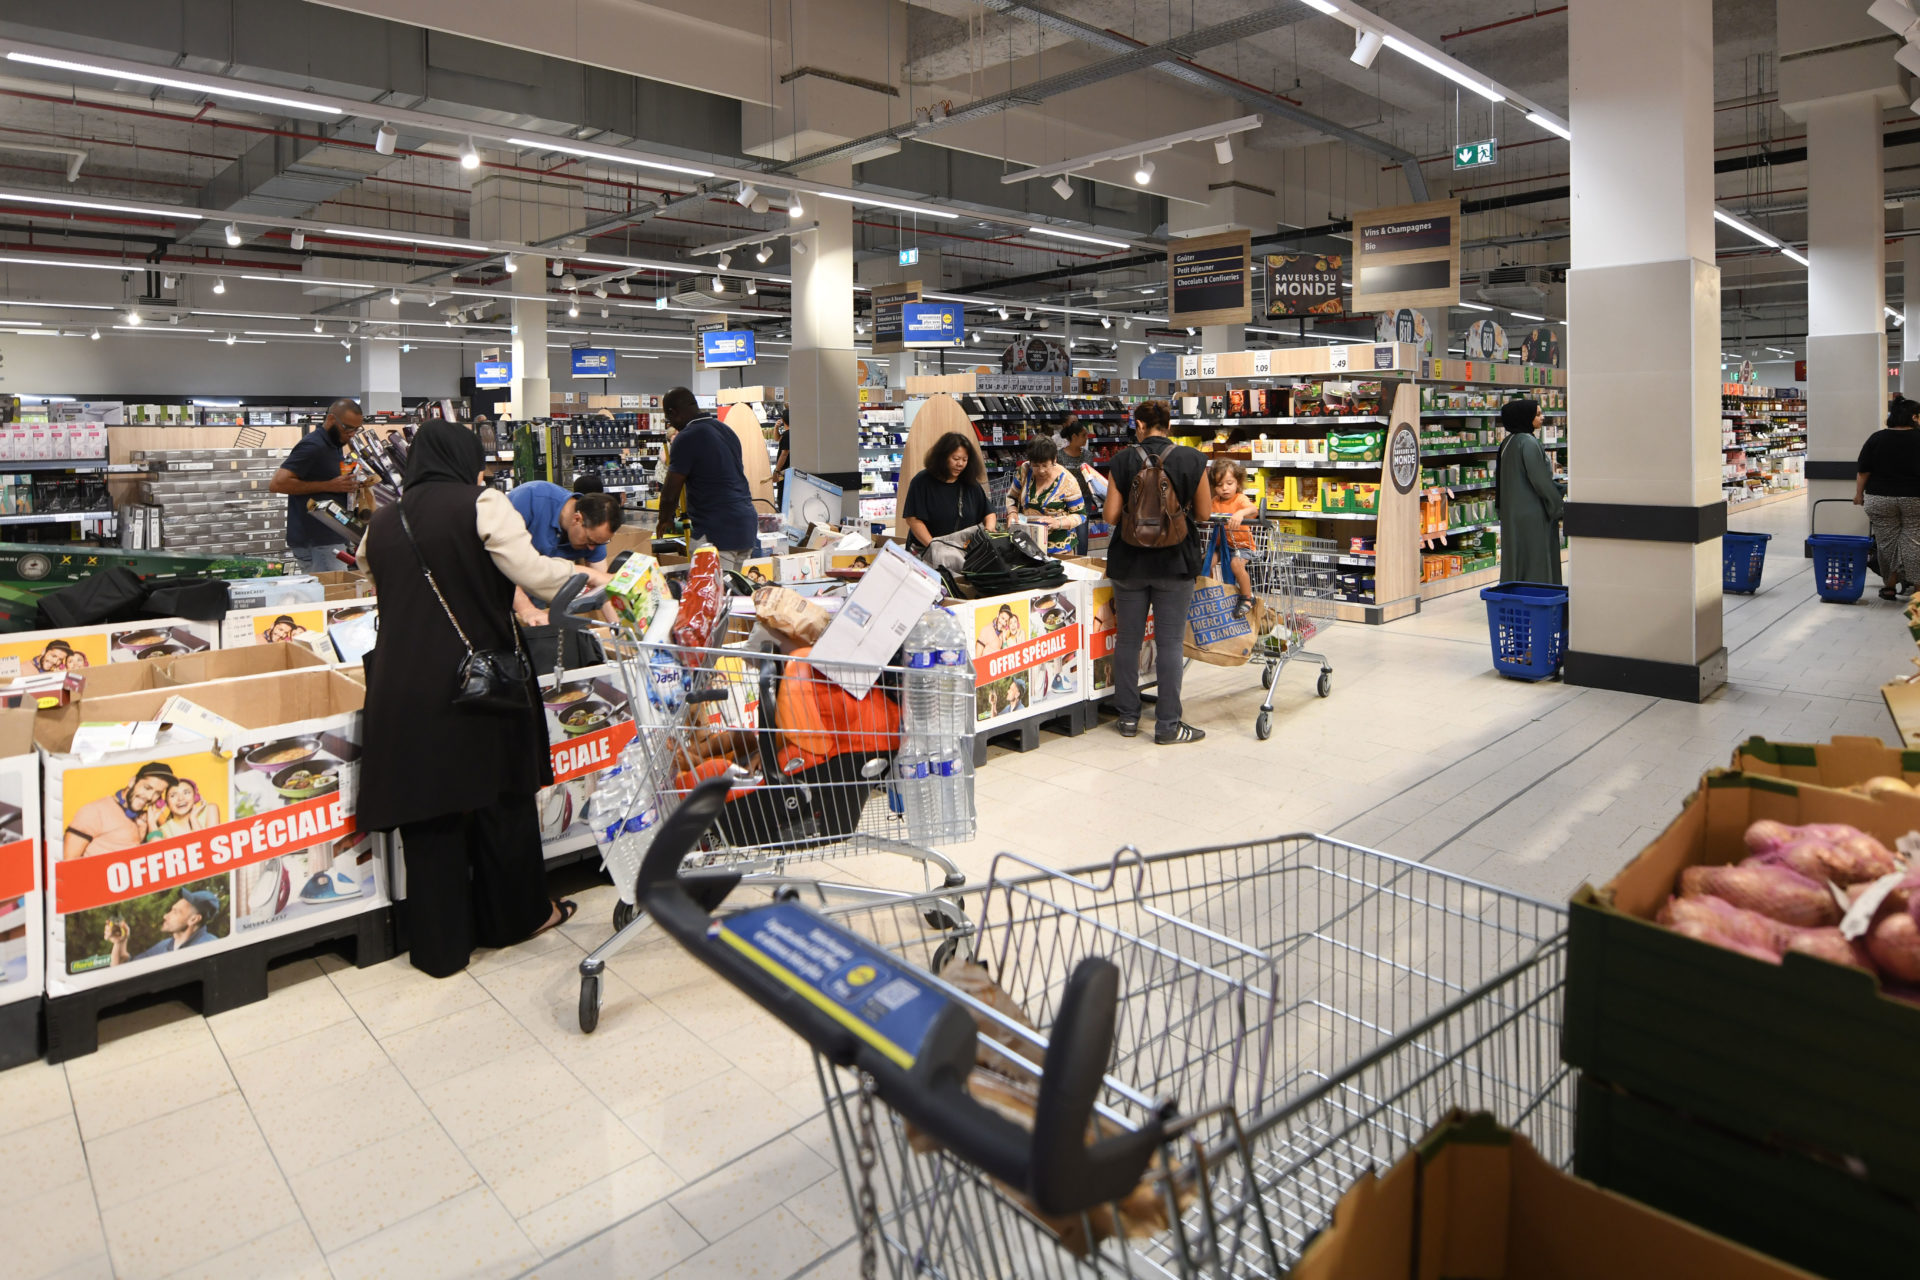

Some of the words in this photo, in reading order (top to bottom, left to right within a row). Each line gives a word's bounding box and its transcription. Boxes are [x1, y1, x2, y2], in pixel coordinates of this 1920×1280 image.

[1364, 228, 1379, 237] Vins
[1381, 227, 1387, 235] &
[1387, 222, 1432, 235] Champagnes
[1365, 243, 1376, 251] Bio
[1191, 265, 1214, 273] déjeuner
[1178, 277, 1203, 286] Chocolats
[1209, 274, 1240, 283] Confiseries
[1275, 274, 1320, 282] SAVEURS
[1275, 283, 1337, 296] MONDE
[1394, 455, 1415, 465] MONDE
[1192, 587, 1223, 602] TILISER
[1189, 602, 1218, 617] VOTRE
[1192, 615, 1223, 631] MERCI
[1196, 633, 1209, 644] LA
[1210, 622, 1249, 641] BANQUISE
[989, 651, 1022, 677] OFFRE
[1022, 633, 1067, 665] SPÉCIALE
[653, 669, 681, 684] Dash
[552, 736, 611, 776] CIALE
[106, 842, 204, 894] OFFRE
[209, 800, 346, 865] SPÉCIALE
